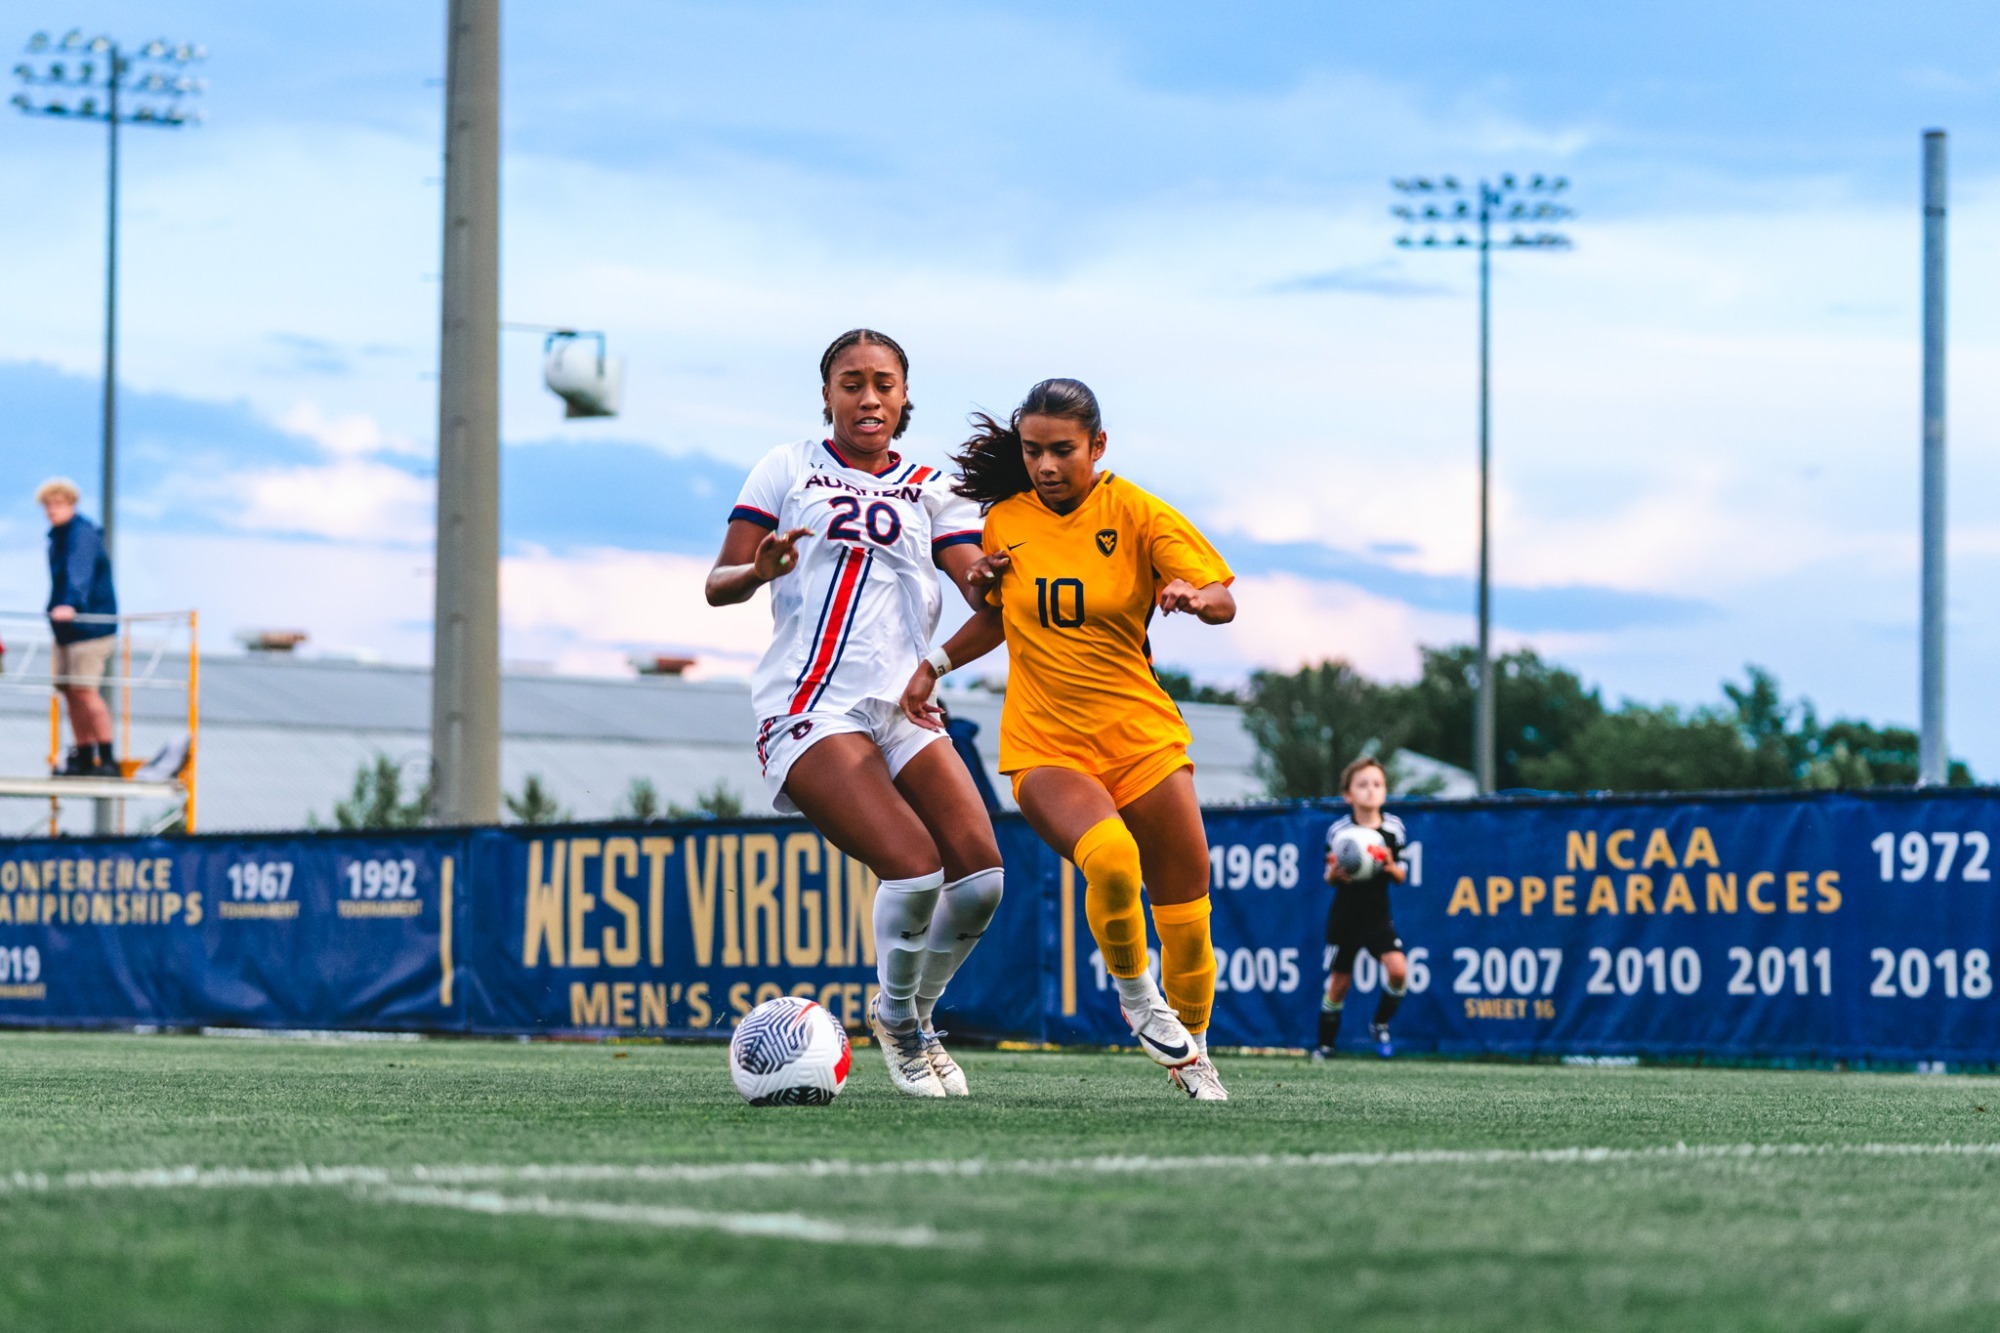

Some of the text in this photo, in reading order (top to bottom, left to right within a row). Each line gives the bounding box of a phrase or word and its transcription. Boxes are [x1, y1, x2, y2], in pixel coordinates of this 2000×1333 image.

[827, 495, 902, 546] 20
[1035, 577, 1085, 628] 10
[1209, 843, 1299, 890] 1968
[1566, 827, 1720, 871] NCAA
[1871, 831, 1991, 882] 1972
[0, 858, 172, 892] ONFERENCE
[227, 861, 294, 900] 1967
[346, 858, 417, 898] 1992
[1446, 870, 1842, 916] APPEARANCES
[523, 837, 674, 968] WEST
[1452, 947, 1562, 995] 2007
[1586, 946, 1701, 995] 2010
[1727, 946, 1831, 996] 2011
[1870, 947, 1993, 999] 2018
[569, 982, 710, 1029] MEN'S
[1464, 999, 1556, 1019] SWEET 16
